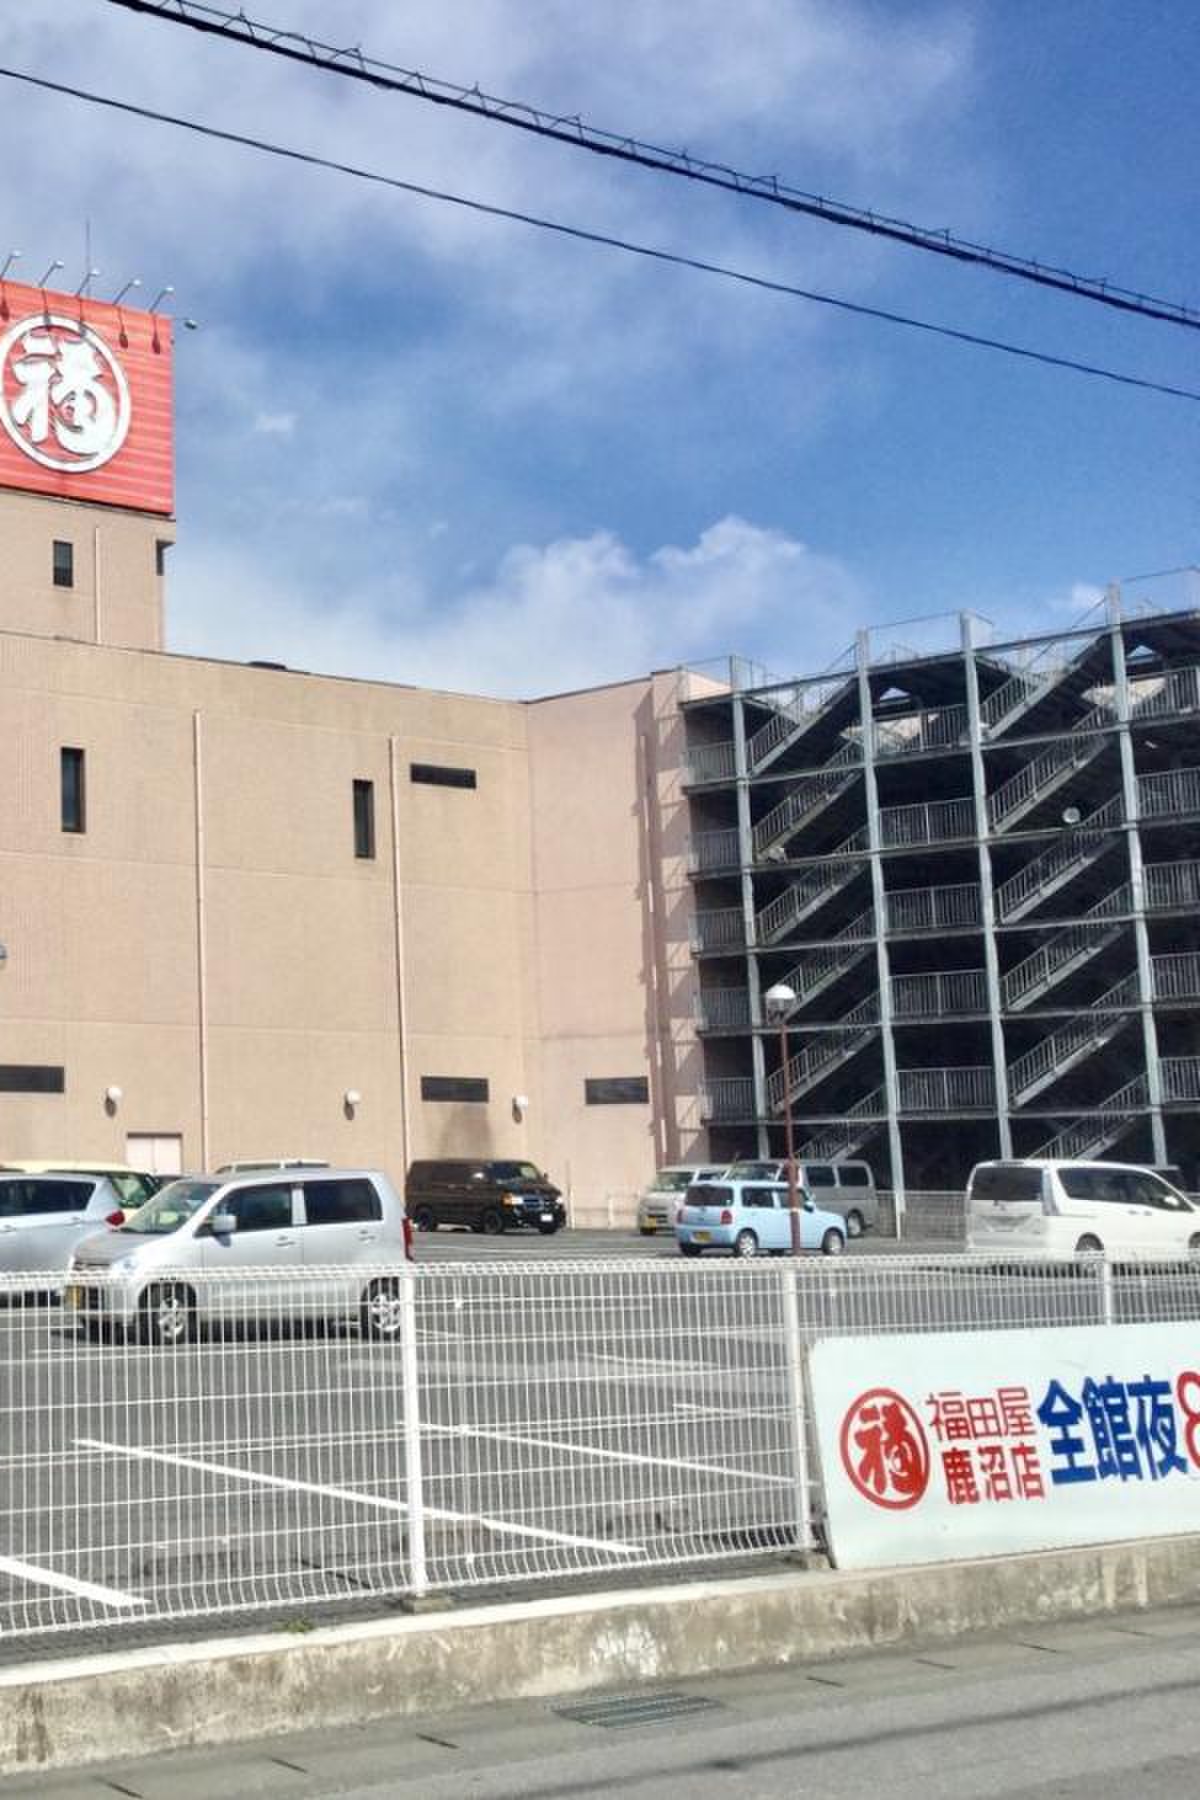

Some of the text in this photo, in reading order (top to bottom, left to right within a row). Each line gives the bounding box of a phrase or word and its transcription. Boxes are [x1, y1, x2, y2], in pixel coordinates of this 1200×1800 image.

[12, 332, 117, 456] 福
[854, 1401, 924, 1496] 福
[925, 1387, 1036, 1441] 福田屋
[942, 1442, 1045, 1504] 鹿沼店
